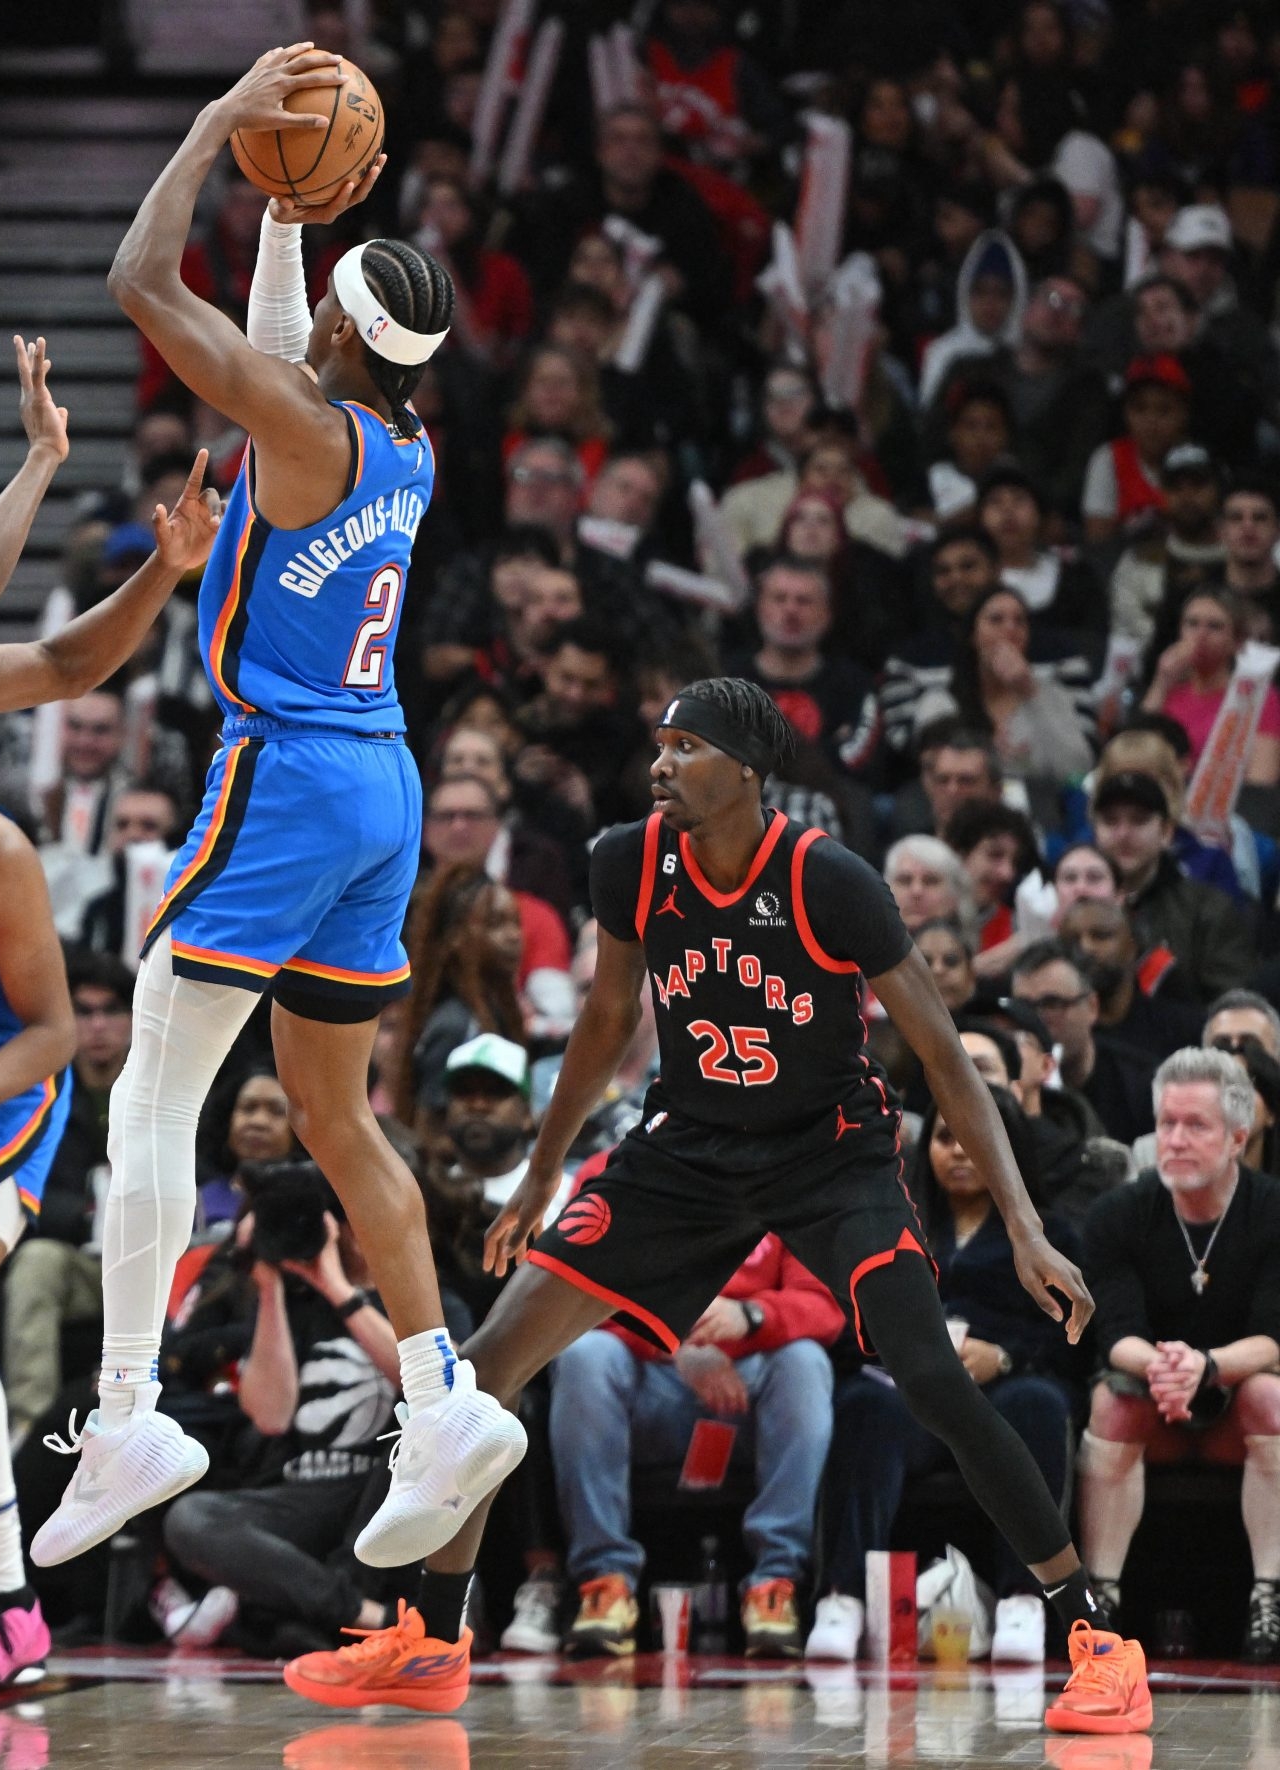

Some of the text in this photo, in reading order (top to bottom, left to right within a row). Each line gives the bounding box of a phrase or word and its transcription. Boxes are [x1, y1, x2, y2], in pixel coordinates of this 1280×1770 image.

[340, 562, 403, 691] 2
[662, 853, 677, 875] 6
[748, 916, 787, 927] Sun Life
[686, 1019, 779, 1087] 25
